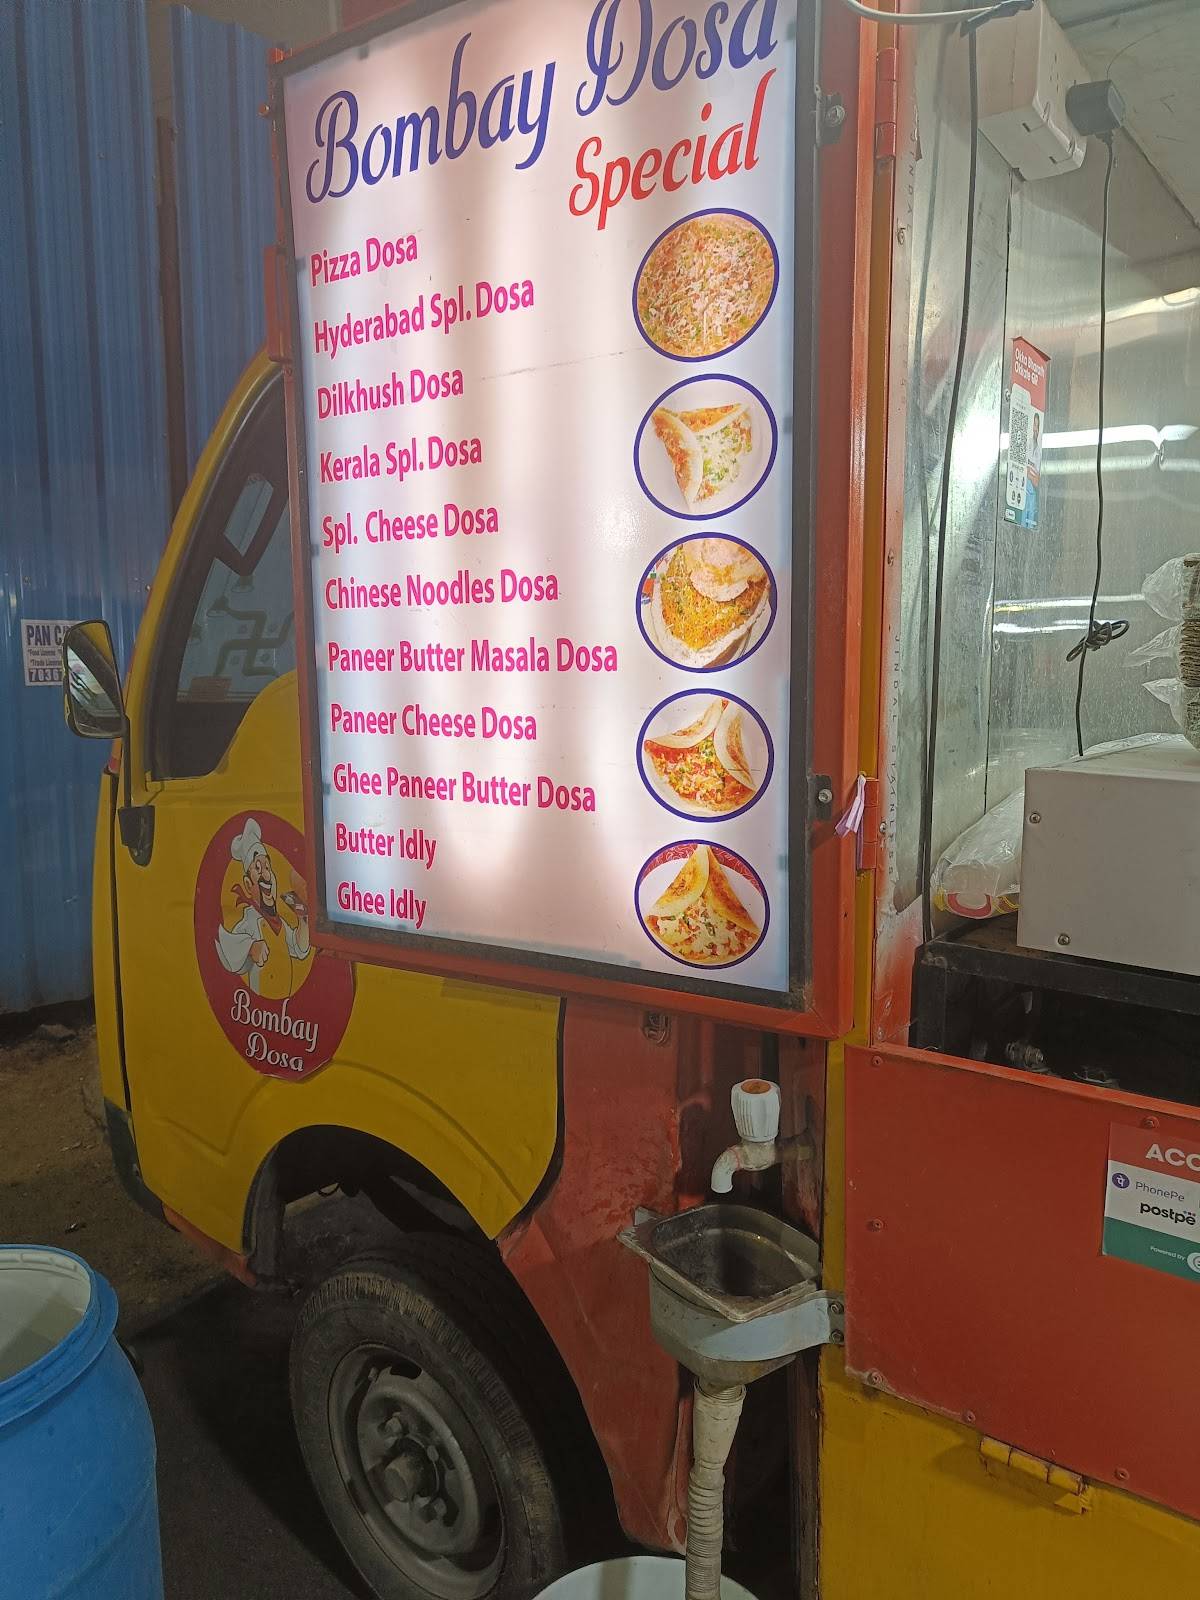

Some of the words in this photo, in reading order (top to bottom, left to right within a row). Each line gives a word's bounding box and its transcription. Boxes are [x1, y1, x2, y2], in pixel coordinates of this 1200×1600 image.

[306, 33, 556, 204] Bombay
[576, 0, 778, 117] Dosa
[569, 67, 777, 231] Special
[311, 250, 360, 286] Pizza
[366, 234, 417, 272] Dosa
[314, 295, 424, 359] Hyderabad
[431, 285, 471, 334] Spl.
[476, 280, 534, 318] Dosa
[318, 372, 404, 419] Dilkhush
[410, 369, 464, 402] Dosa
[321, 445, 380, 483] Kerala
[386, 438, 424, 481] Spl.
[428, 436, 482, 469] Dosa
[323, 513, 358, 554] Spl.
[366, 510, 438, 542] Cheese
[444, 504, 499, 536] Dosa
[325, 578, 401, 609] Chinese
[407, 570, 494, 606] Noodles
[501, 569, 558, 602] Dosa
[26, 625, 51, 646] PAN
[328, 642, 395, 672] Paneer
[400, 641, 465, 672] Butter
[472, 637, 549, 672] Masala
[557, 638, 618, 672] Dosa
[331, 703, 397, 734] Paneer
[403, 704, 475, 737] Cheese
[482, 707, 537, 740] Dosa
[334, 764, 381, 795] Ghee
[388, 767, 456, 800] Paneer
[463, 772, 531, 806] Butter
[537, 776, 596, 811] Dosa
[336, 823, 394, 857] Butter
[400, 829, 436, 869] Idly
[338, 882, 384, 915] Ghee
[390, 889, 426, 929] Idly
[231, 988, 319, 1053] Bombay
[246, 1032, 303, 1071] Dosa
[1135, 1181, 1185, 1202] PhonePe
